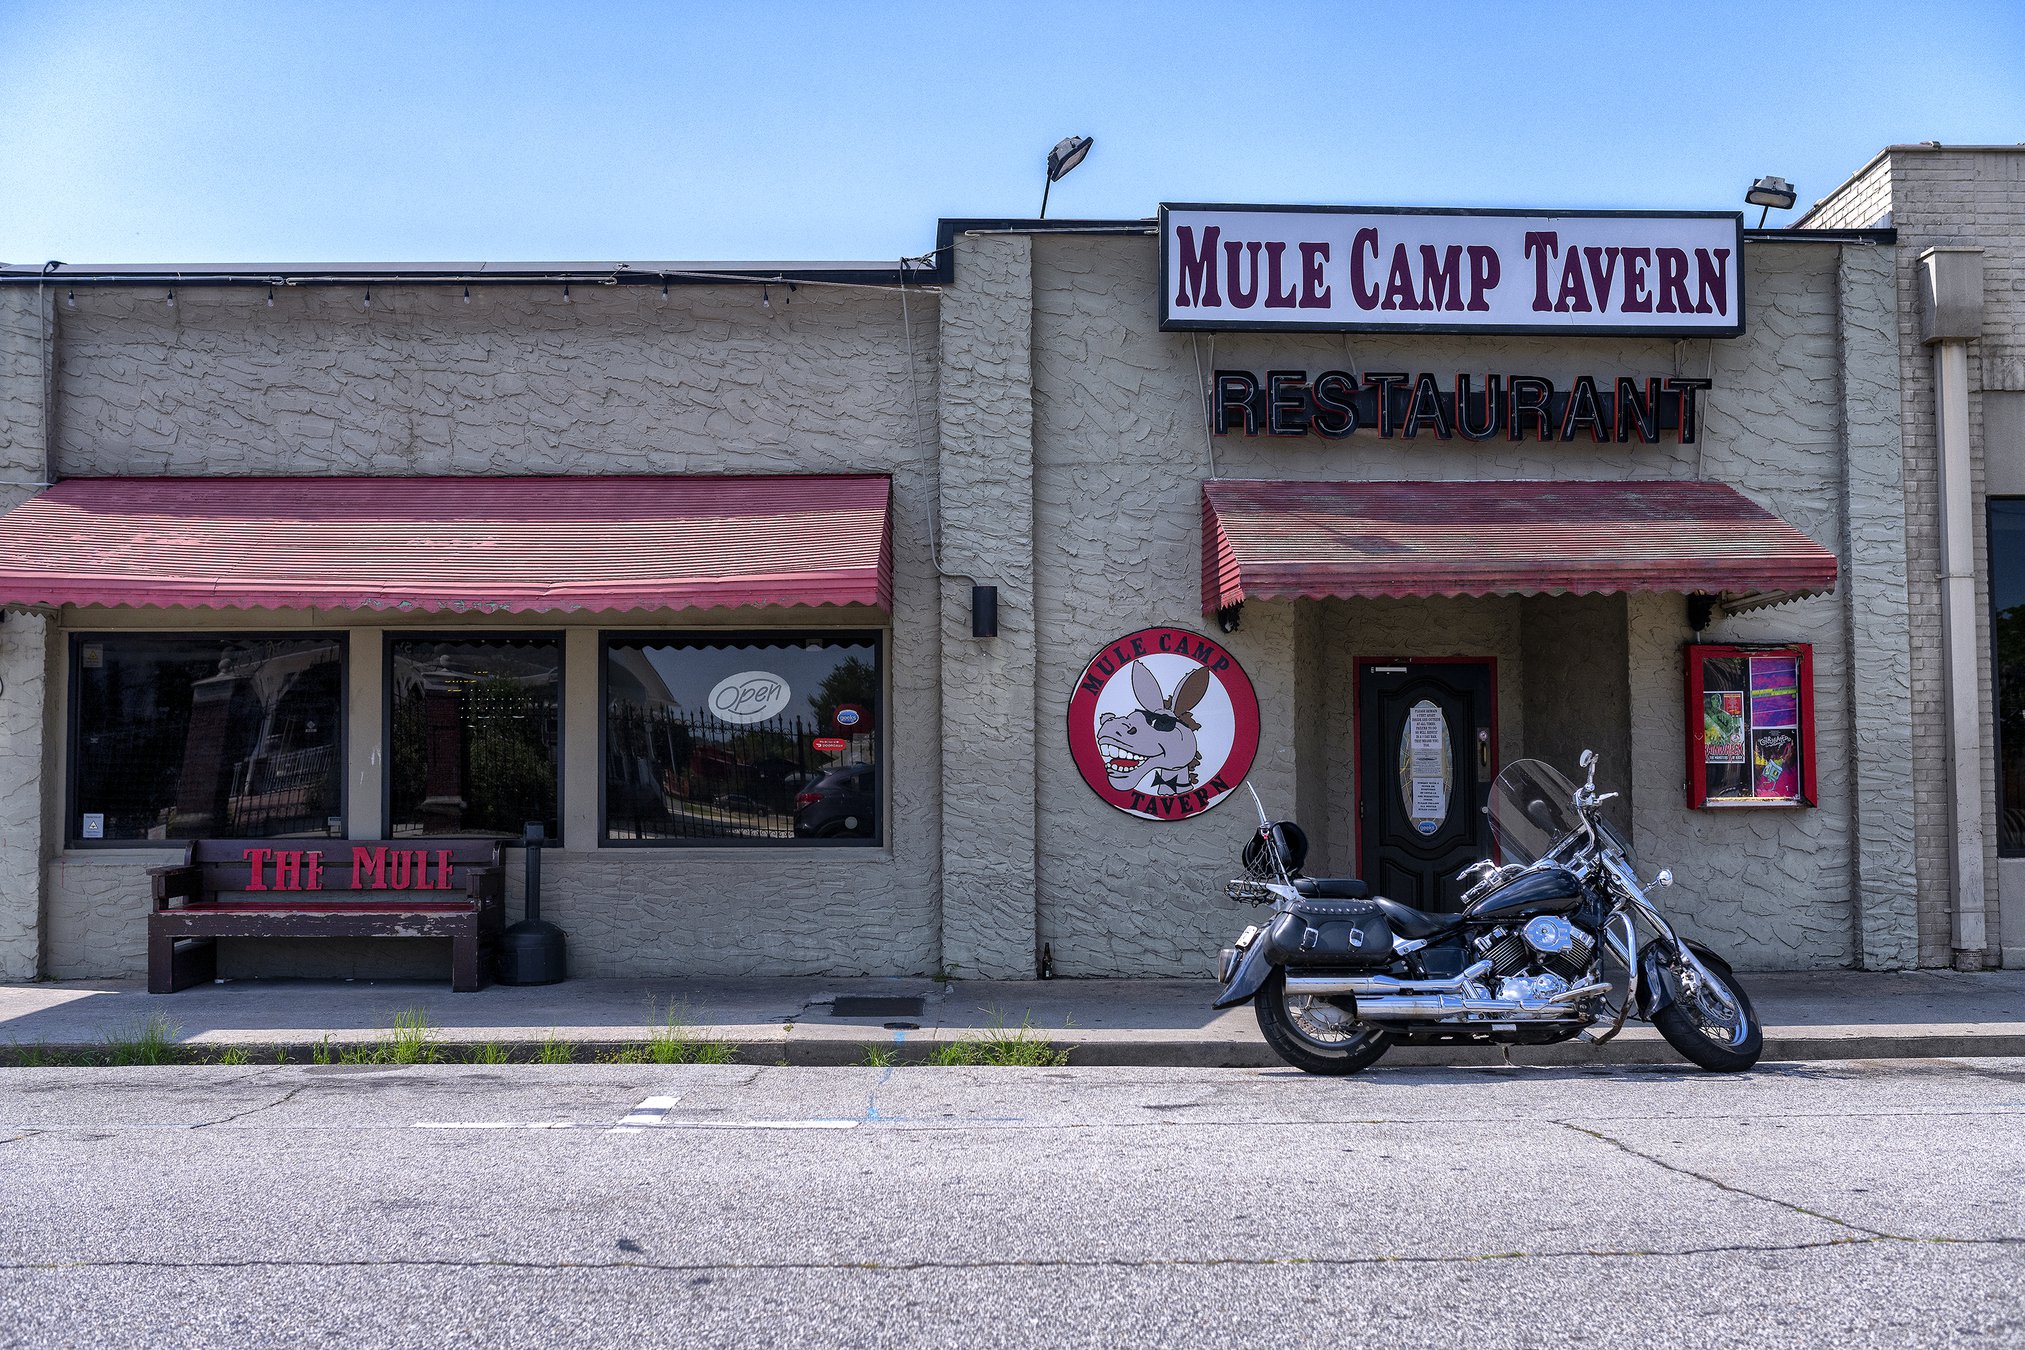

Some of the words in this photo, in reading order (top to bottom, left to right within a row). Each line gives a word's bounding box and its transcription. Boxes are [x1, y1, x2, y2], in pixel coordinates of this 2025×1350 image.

[1212, 369, 1713, 444] RESTAURANT
[1081, 637, 1148, 697] MULE
[1158, 633, 1230, 673] CAMP
[715, 682, 782, 712] Open
[1130, 774, 1230, 815] TAVERN
